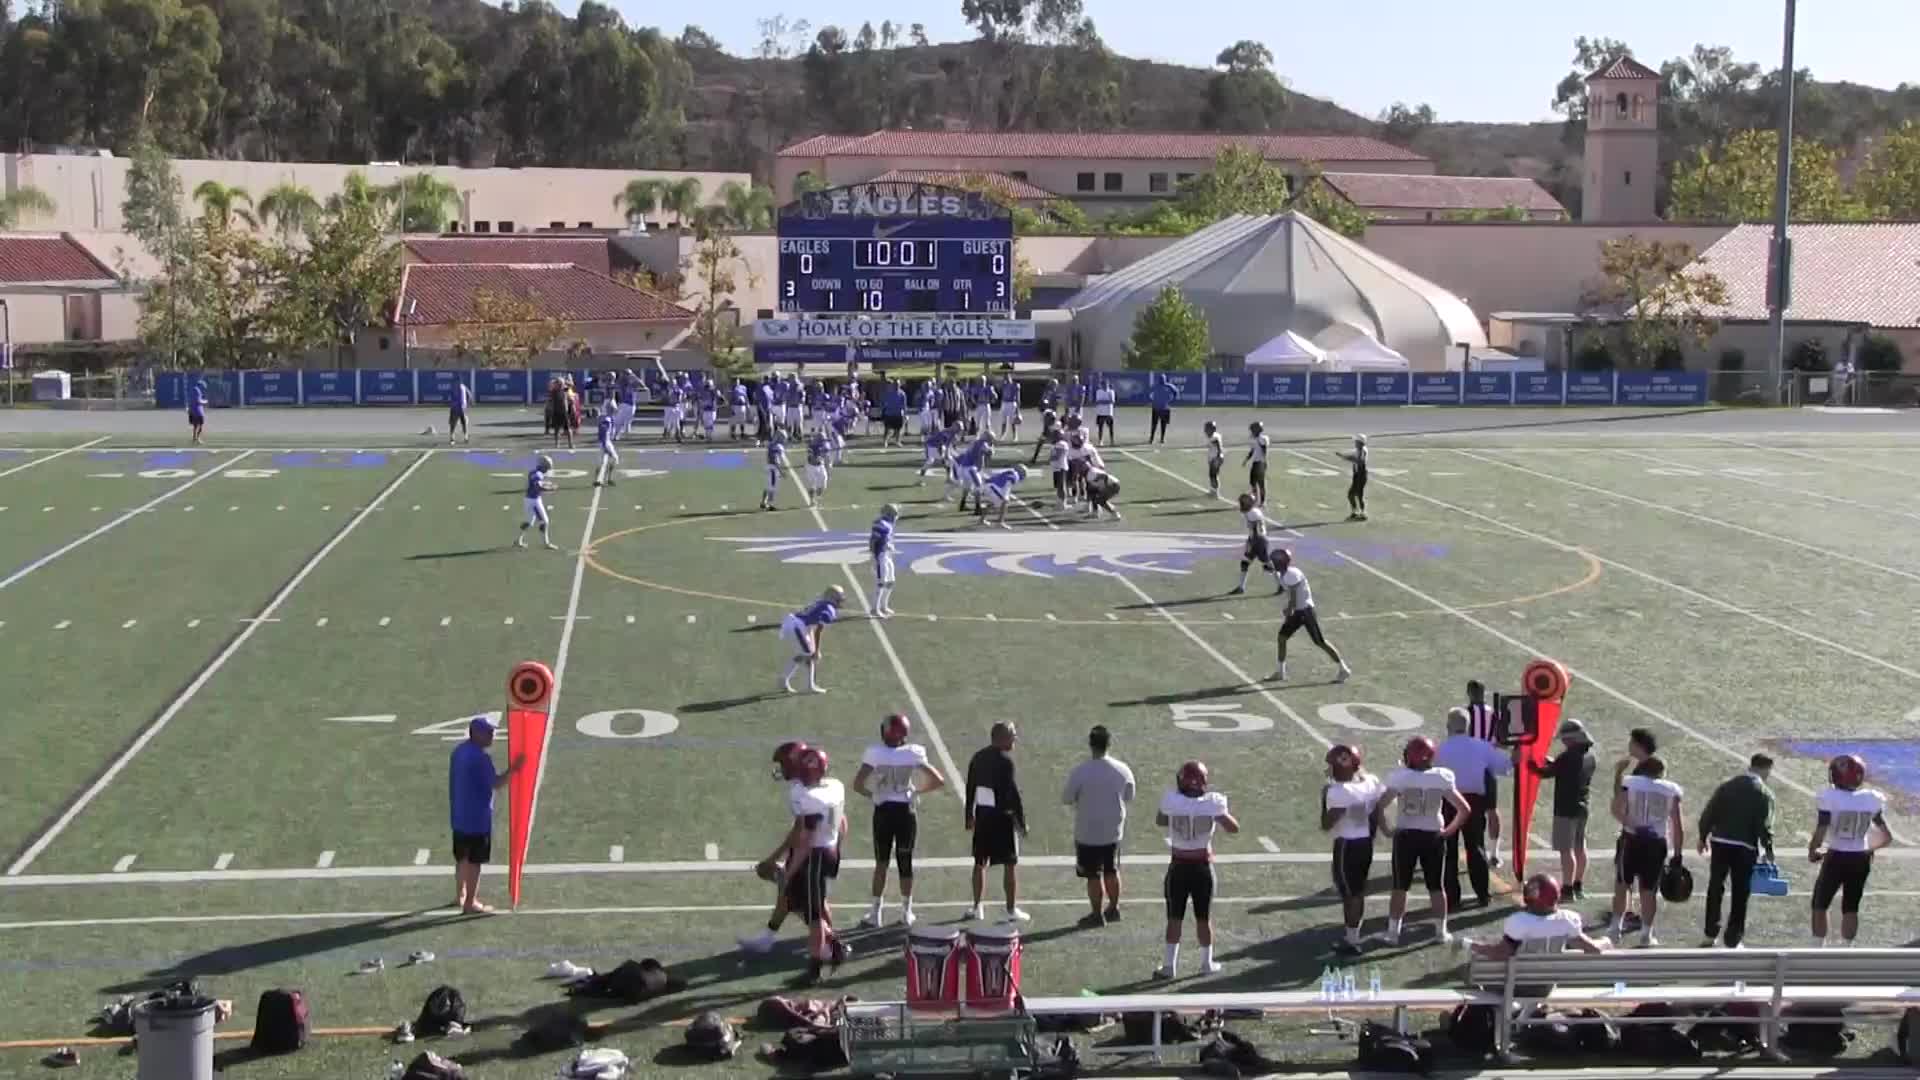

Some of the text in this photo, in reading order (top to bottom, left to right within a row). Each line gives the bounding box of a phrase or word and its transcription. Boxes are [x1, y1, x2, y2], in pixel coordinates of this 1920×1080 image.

[831, 194, 961, 216] EAGLES
[781, 240, 830, 254] EAGLES
[963, 240, 1006, 254] GUEST
[801, 254, 813, 274] 0
[992, 254, 1005, 275] 0
[786, 280, 796, 297] 3
[811, 279, 842, 290] DOWN
[996, 281, 1005, 297] 3
[798, 321, 852, 337] HOME
[858, 321, 882, 337] OF
[887, 321, 924, 337] THE
[931, 321, 993, 337] EAGLES
